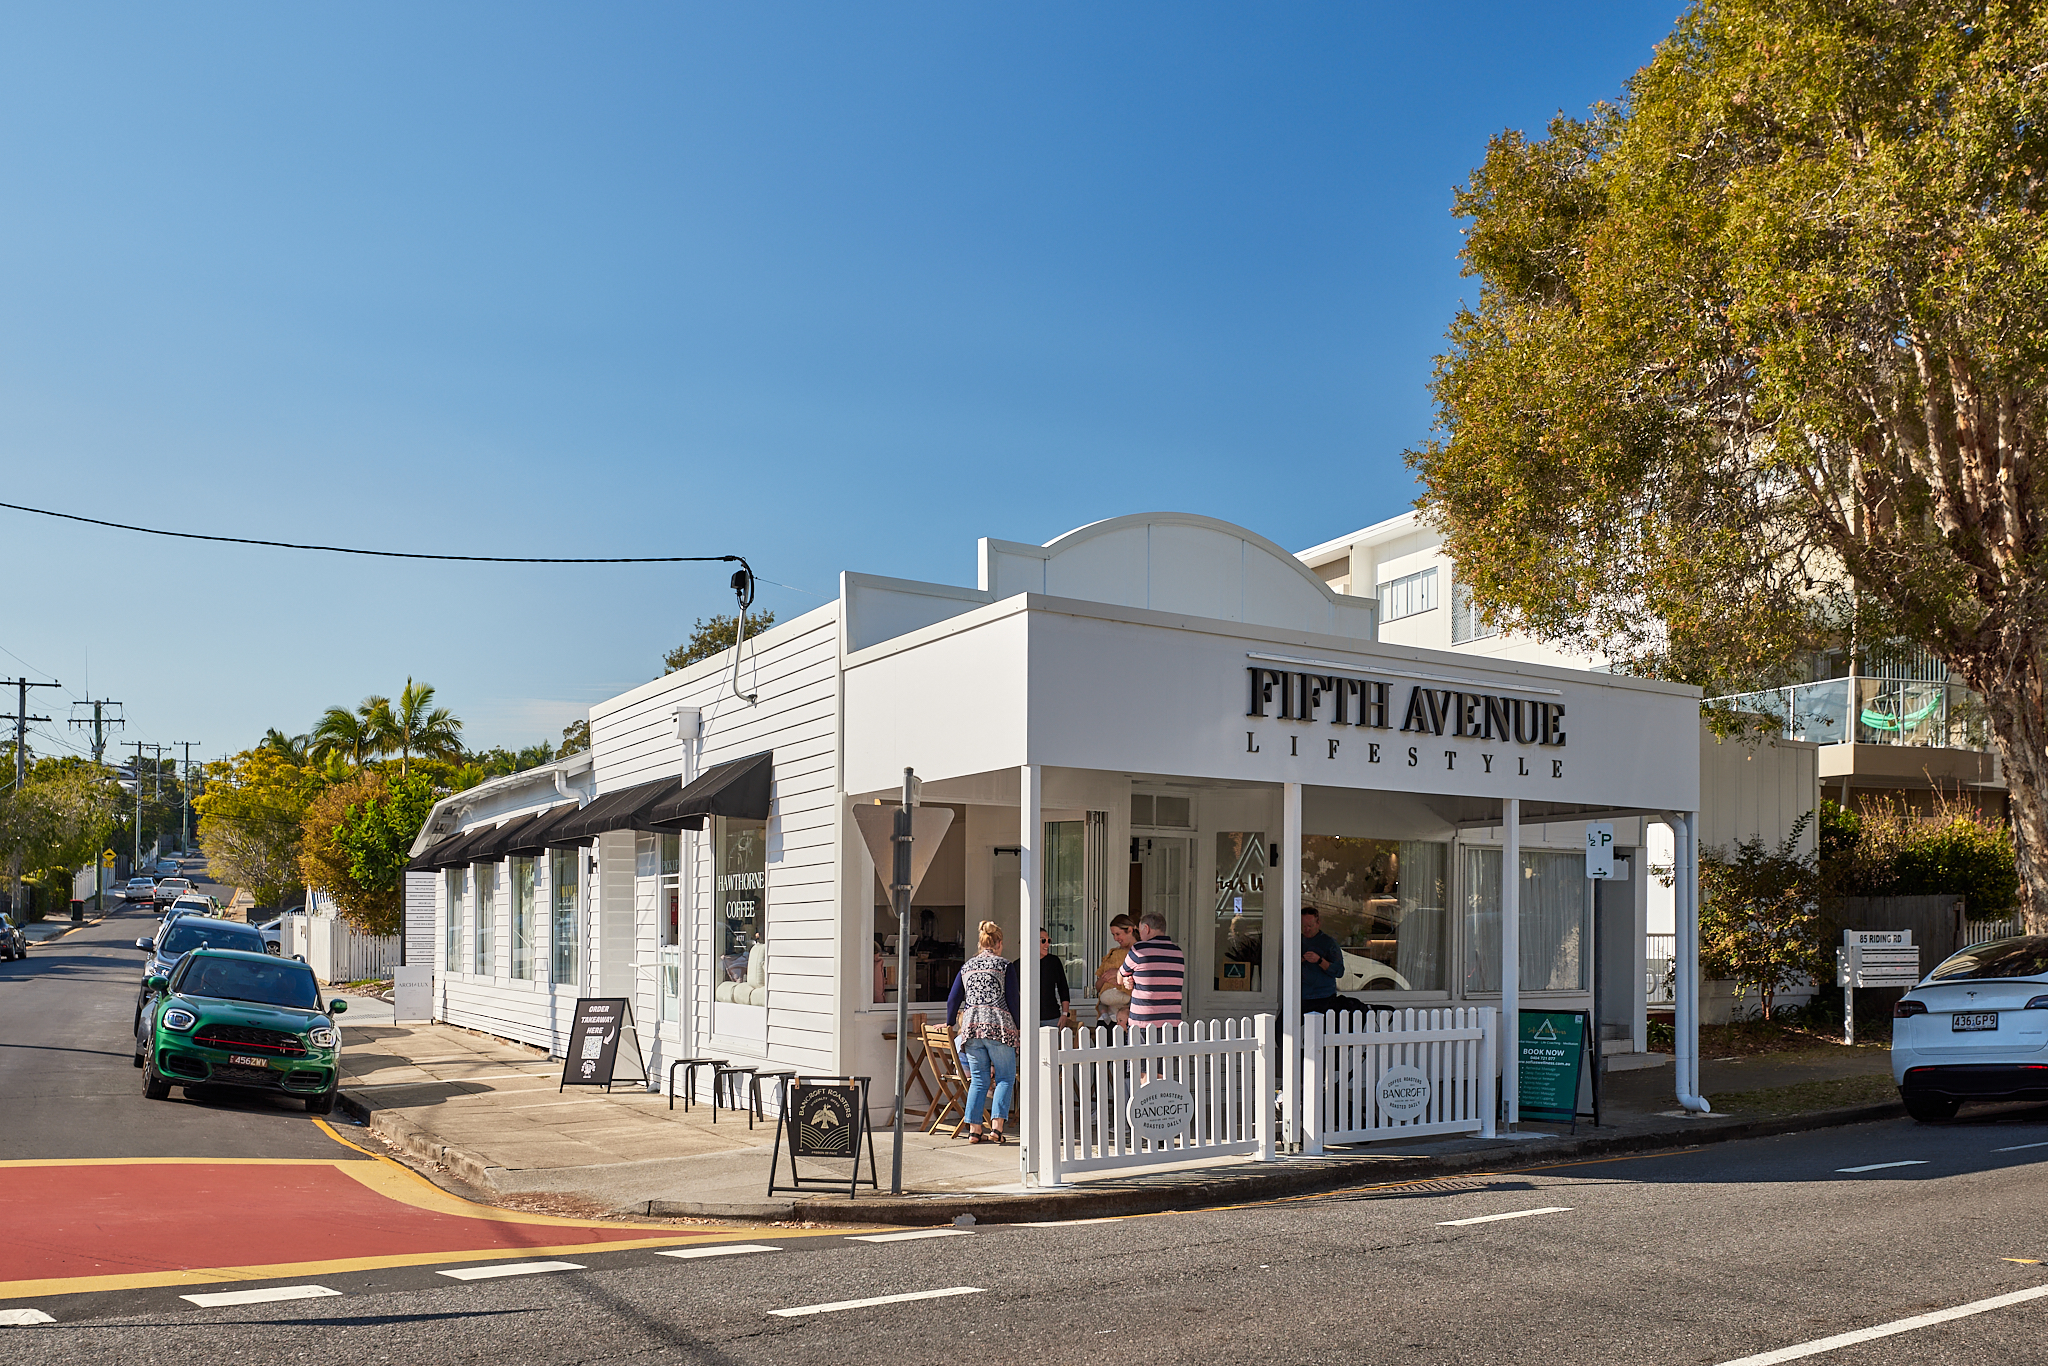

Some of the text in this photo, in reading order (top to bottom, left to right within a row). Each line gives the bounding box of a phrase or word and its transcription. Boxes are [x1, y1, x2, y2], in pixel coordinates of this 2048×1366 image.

[1246, 667, 1566, 747] FIFTH AVENUE
[1246, 731, 1563, 778] LIFESTYLE
[718, 872, 764, 891] HAWTHORNE
[726, 900, 756, 918] COFFEE
[1860, 934, 1902, 943] 85 RIDING RD
[1955, 1014, 1996, 1026] 436 GP9
[1141, 1093, 1183, 1106] COFFEE ROASTERS
[1383, 1087, 1426, 1099] BANCROFT
[798, 1088, 852, 1118] BANCROFT ROASTERS
[1135, 1103, 1190, 1119] BANCROFT
[1167, 1119, 1182, 1128] DAILY
